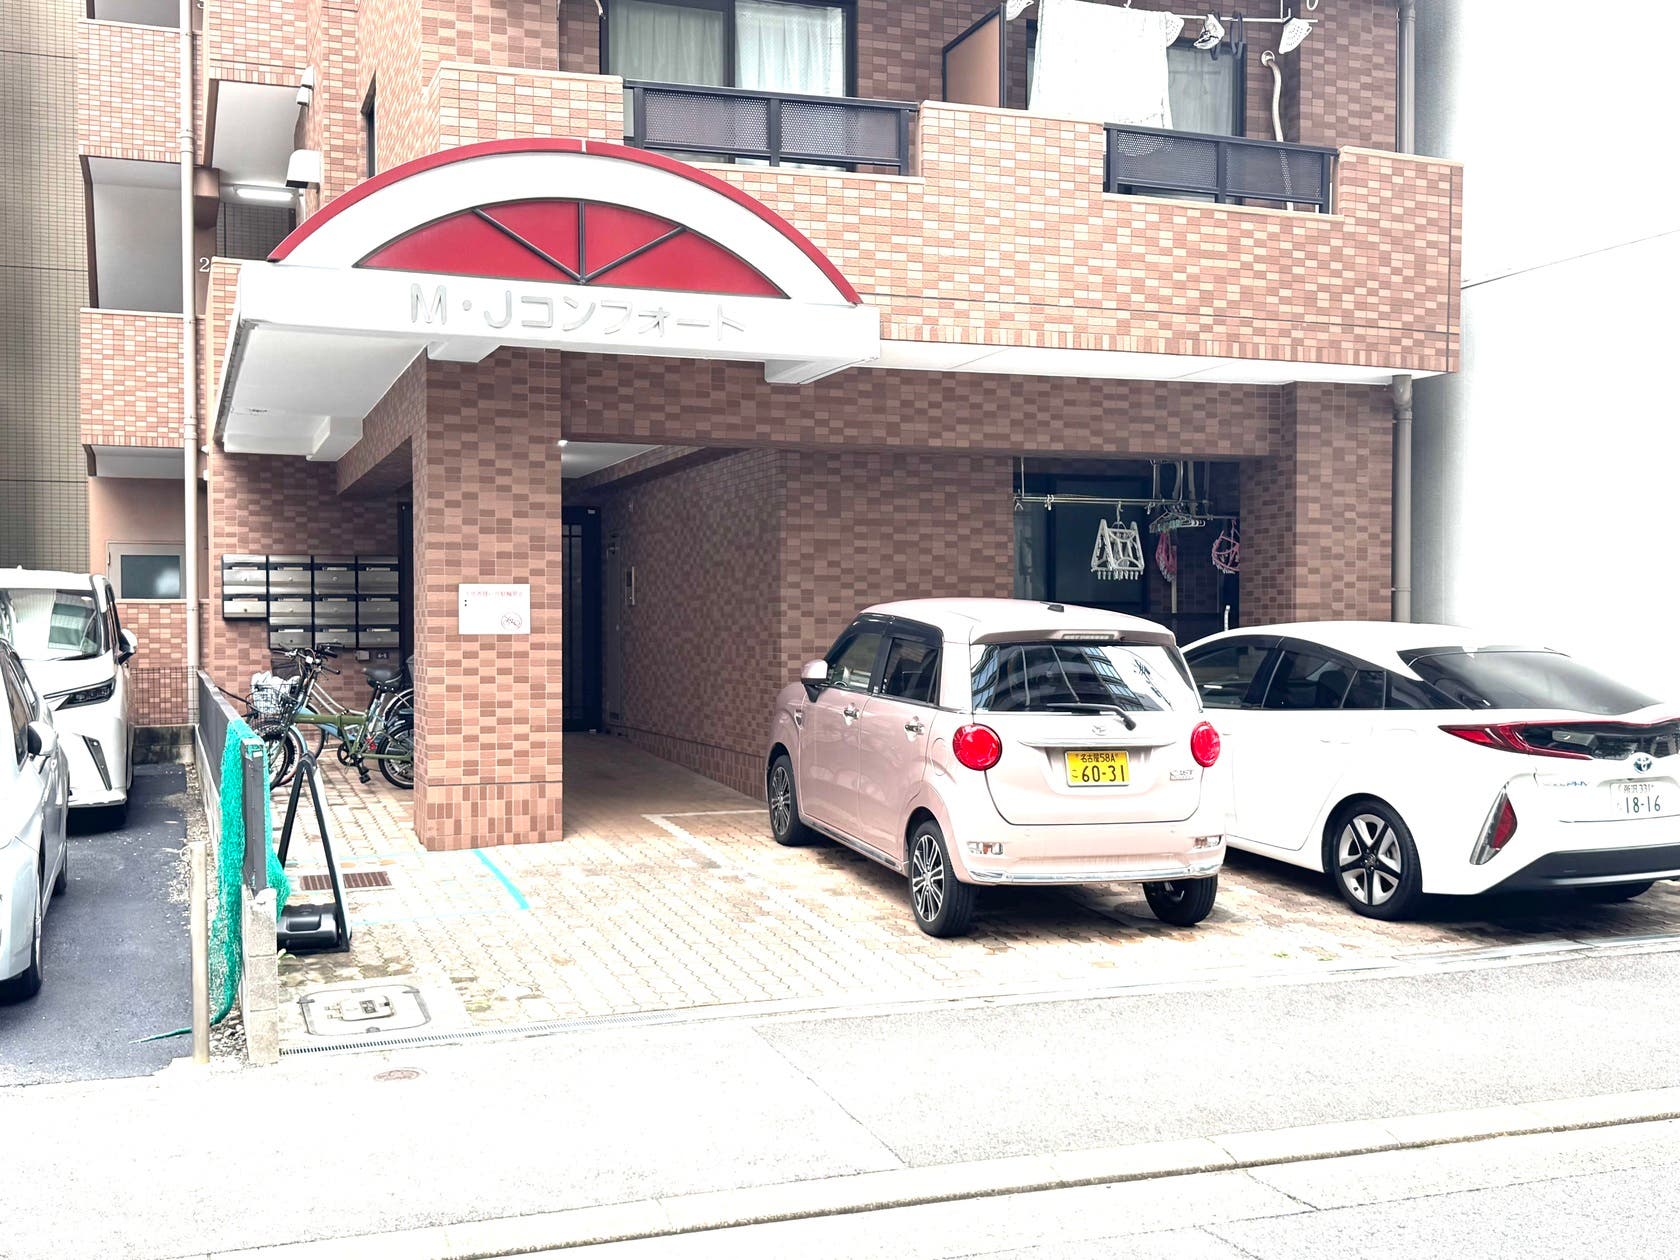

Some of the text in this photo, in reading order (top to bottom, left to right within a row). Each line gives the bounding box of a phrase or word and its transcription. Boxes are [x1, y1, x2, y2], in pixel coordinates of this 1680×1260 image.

[199, 257, 210, 273] 2
[1081, 764, 1125, 782] 60-31
[1625, 795, 1661, 814] 18-16
